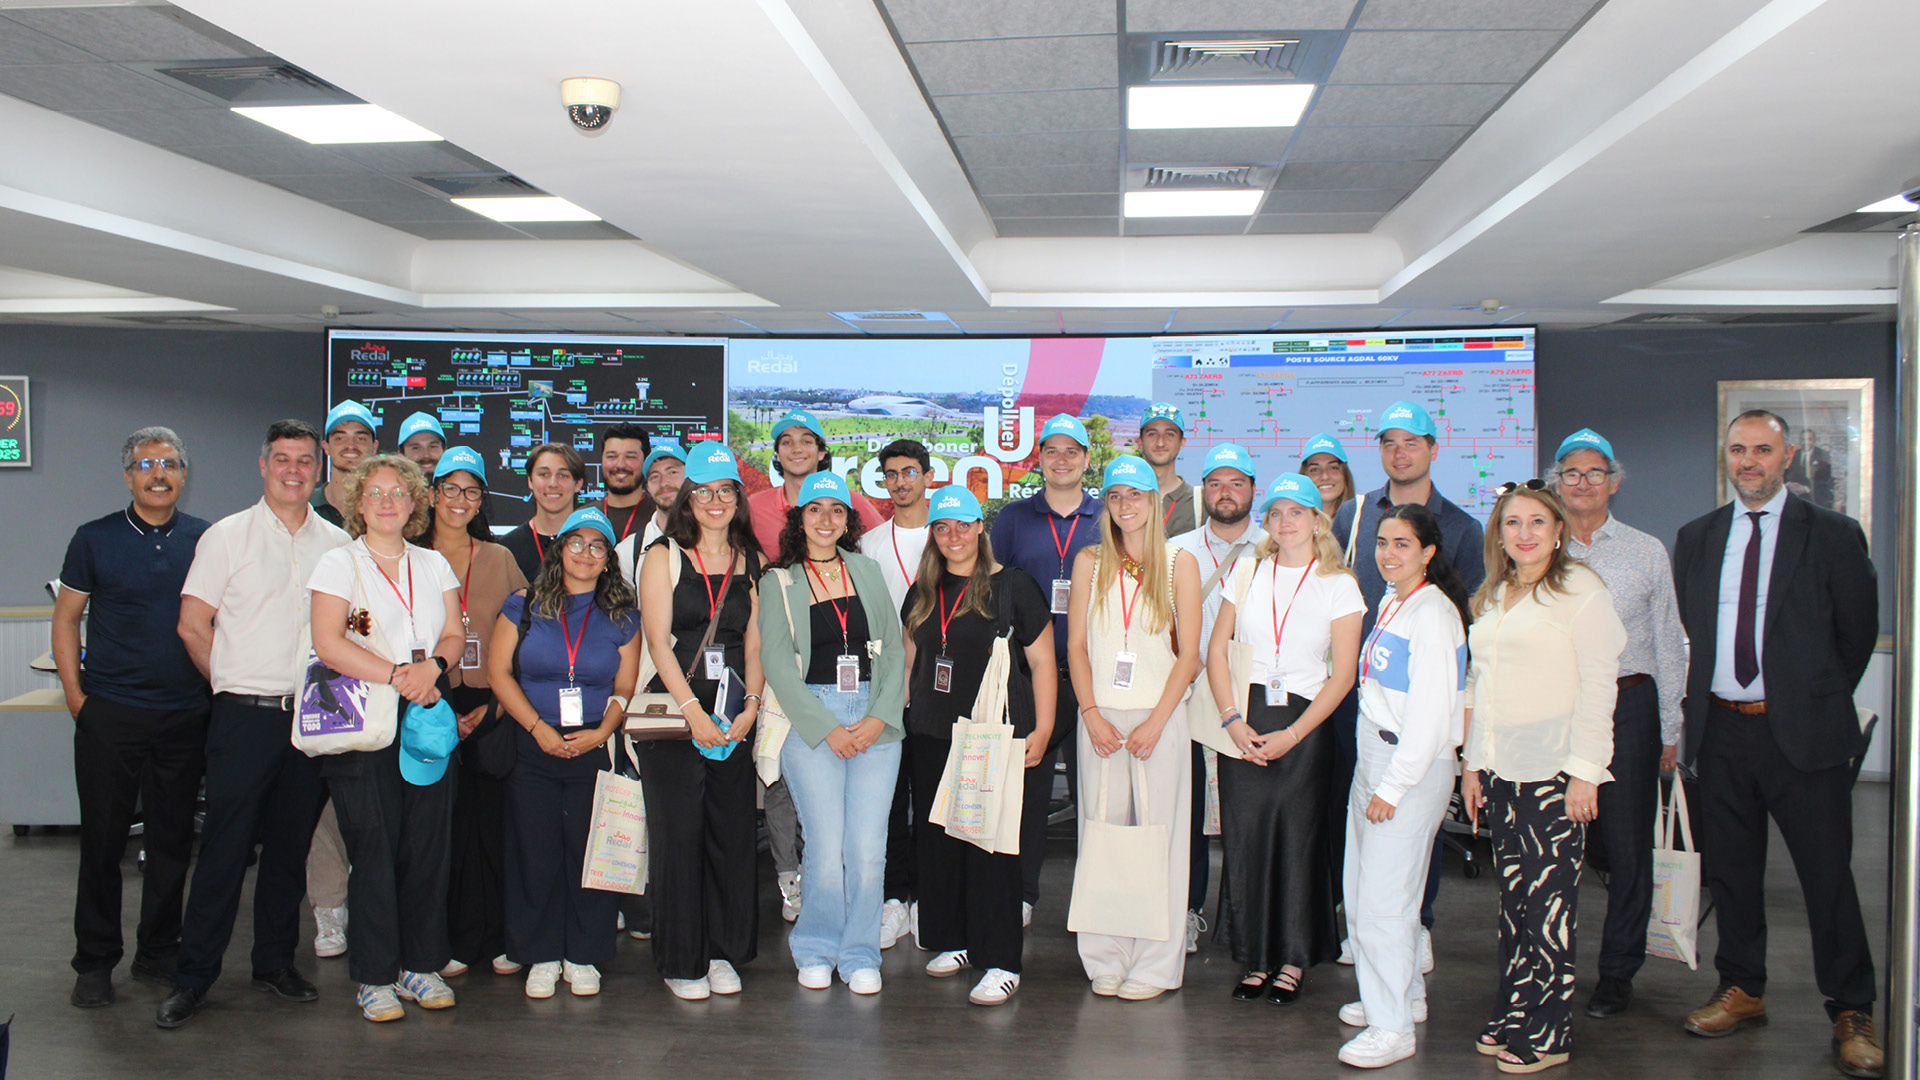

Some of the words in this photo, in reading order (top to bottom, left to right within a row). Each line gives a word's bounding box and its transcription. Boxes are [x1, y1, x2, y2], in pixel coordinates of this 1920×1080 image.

[351, 350, 390, 361] Redal
[748, 360, 798, 374] Redal
[997, 364, 1019, 448] Dépolluer
[452, 455, 476, 464] Redal
[708, 455, 730, 464] Redal
[1112, 467, 1136, 476] Redal
[1274, 484, 1300, 493] Redal
[938, 500, 960, 510] Redal
[606, 836, 632, 849] Redal
[590, 878, 632, 890] VALORISER
